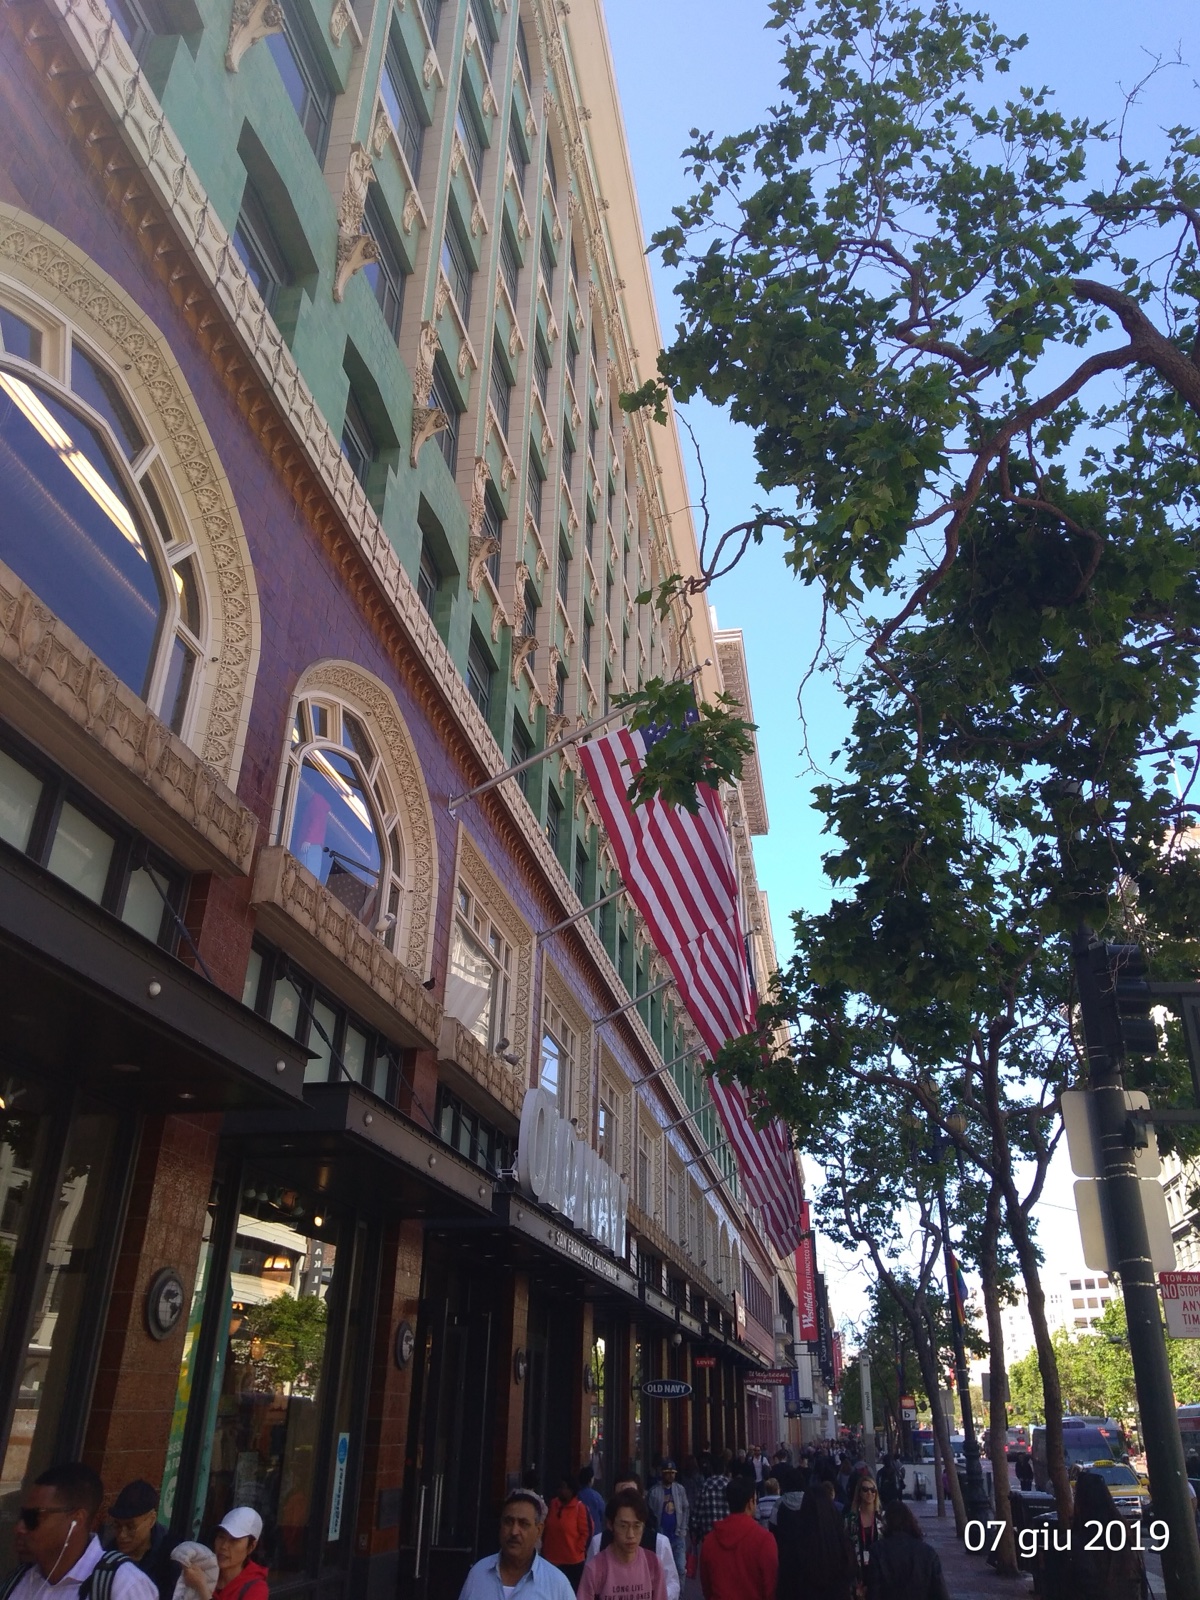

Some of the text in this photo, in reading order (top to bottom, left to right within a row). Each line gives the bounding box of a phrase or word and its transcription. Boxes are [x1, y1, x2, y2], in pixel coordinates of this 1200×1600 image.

[556, 1230, 569, 1250] SAN
[804, 1249, 812, 1279] FRANCISCO
[1161, 1284, 1177, 1298] NO
[802, 1290, 815, 1329] Westfield
[647, 1384, 686, 1393] OLD NAVY
[612, 1584, 644, 1593] LONG LIVE
